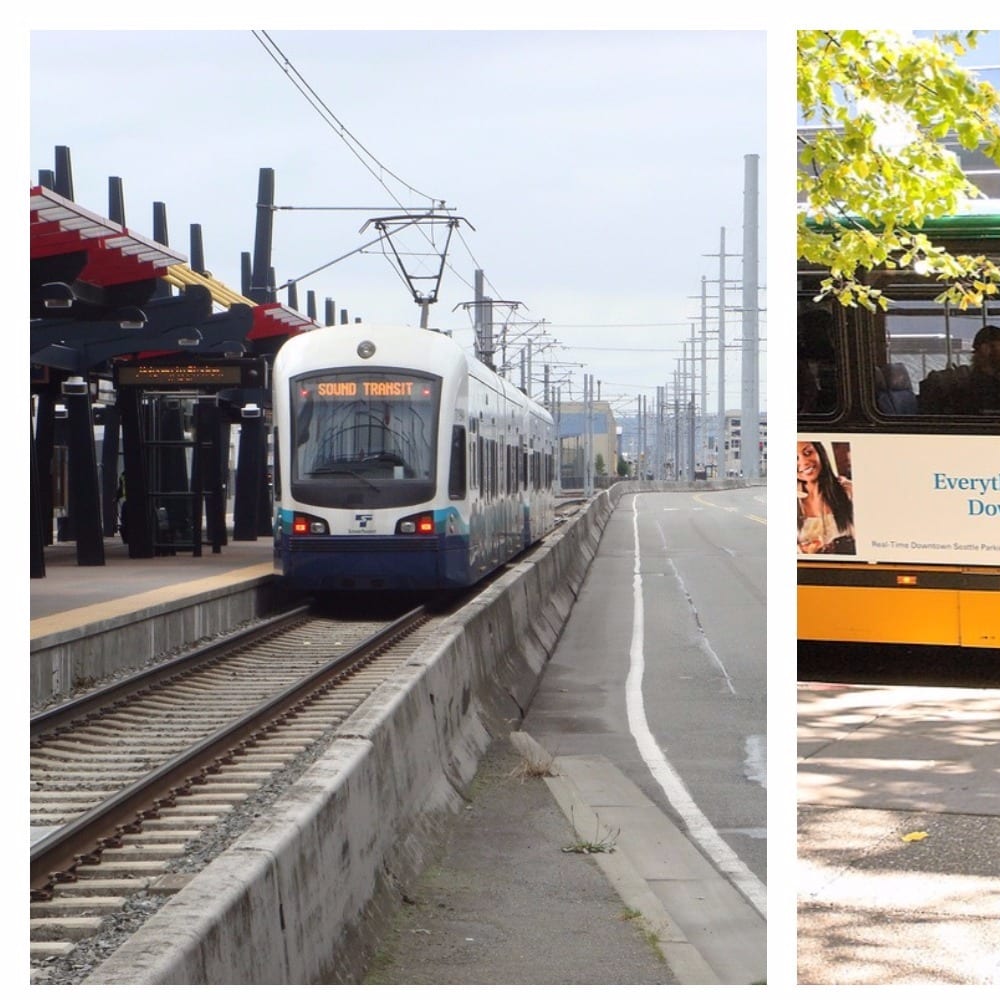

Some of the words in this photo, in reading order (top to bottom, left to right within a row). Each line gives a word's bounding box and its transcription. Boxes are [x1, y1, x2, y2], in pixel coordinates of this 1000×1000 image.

[318, 382, 357, 396] SOUND
[363, 382, 414, 396] TRANSIT
[871, 541, 909, 549] Real-Time
[911, 541, 951, 551] Downtown
[953, 542, 979, 551] Seattle
